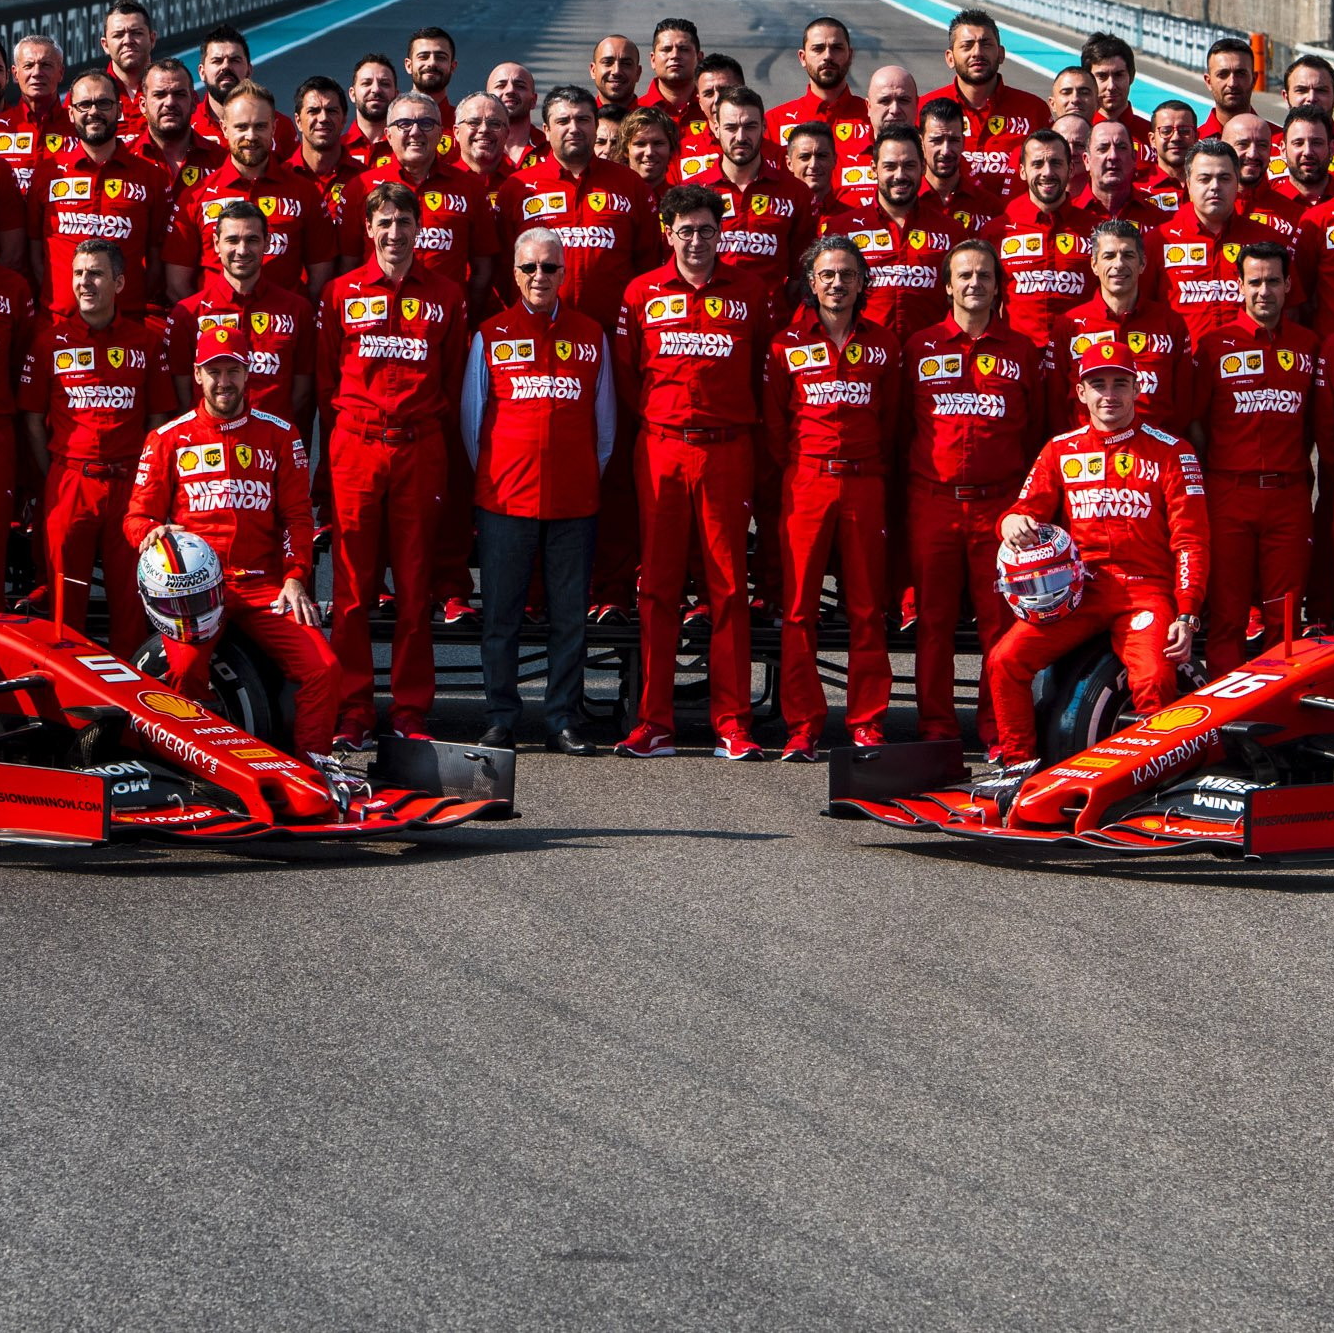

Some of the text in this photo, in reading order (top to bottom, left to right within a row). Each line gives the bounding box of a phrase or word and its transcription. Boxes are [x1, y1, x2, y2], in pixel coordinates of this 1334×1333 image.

[74, 184, 89, 193] ups
[58, 212, 131, 227] MISSION
[58, 223, 131, 239] WINNOW
[1013, 271, 1084, 284] MISSION
[1015, 281, 1084, 294] WINNOW
[371, 303, 386, 313] ups
[671, 301, 684, 311] ups
[360, 335, 428, 349] MISSION
[660, 332, 732, 346] MISSION
[358, 346, 427, 360] WINNOW
[518, 346, 532, 355] ups
[659, 343, 733, 357] WINNOW
[511, 376, 581, 389] MISSION
[803, 381, 871, 395] MISSION
[65, 386, 135, 398] MISSION
[511, 387, 581, 400] WINNOW
[806, 391, 870, 405] WINNOW
[1234, 389, 1302, 404] MISSION
[68, 396, 135, 409] WINNOW
[933, 394, 1005, 406] MISSION
[1235, 400, 1301, 414] WINNOW
[933, 404, 1005, 417] WINNOW
[205, 453, 221, 464] ups
[1088, 462, 1102, 473] ups
[184, 479, 270, 497] MISSION
[189, 494, 271, 512] WINNOW
[1068, 489, 1152, 505] MISSION
[1072, 502, 1152, 519] WINNOW
[167, 567, 207, 583] MISSION
[73, 654, 142, 684] 5
[1194, 670, 1286, 699] 16
[193, 726, 228, 736] AMD
[130, 713, 211, 770] KASPERSKY
[1110, 736, 1148, 747] AMD
[1131, 730, 1209, 786] KASPERSKY
[1049, 768, 1102, 780] MAHLE
[1196, 775, 1257, 794] MISS
[1193, 794, 1244, 812] WINN
[135, 809, 214, 824] V-Power
[1164, 825, 1236, 837] V-Power
